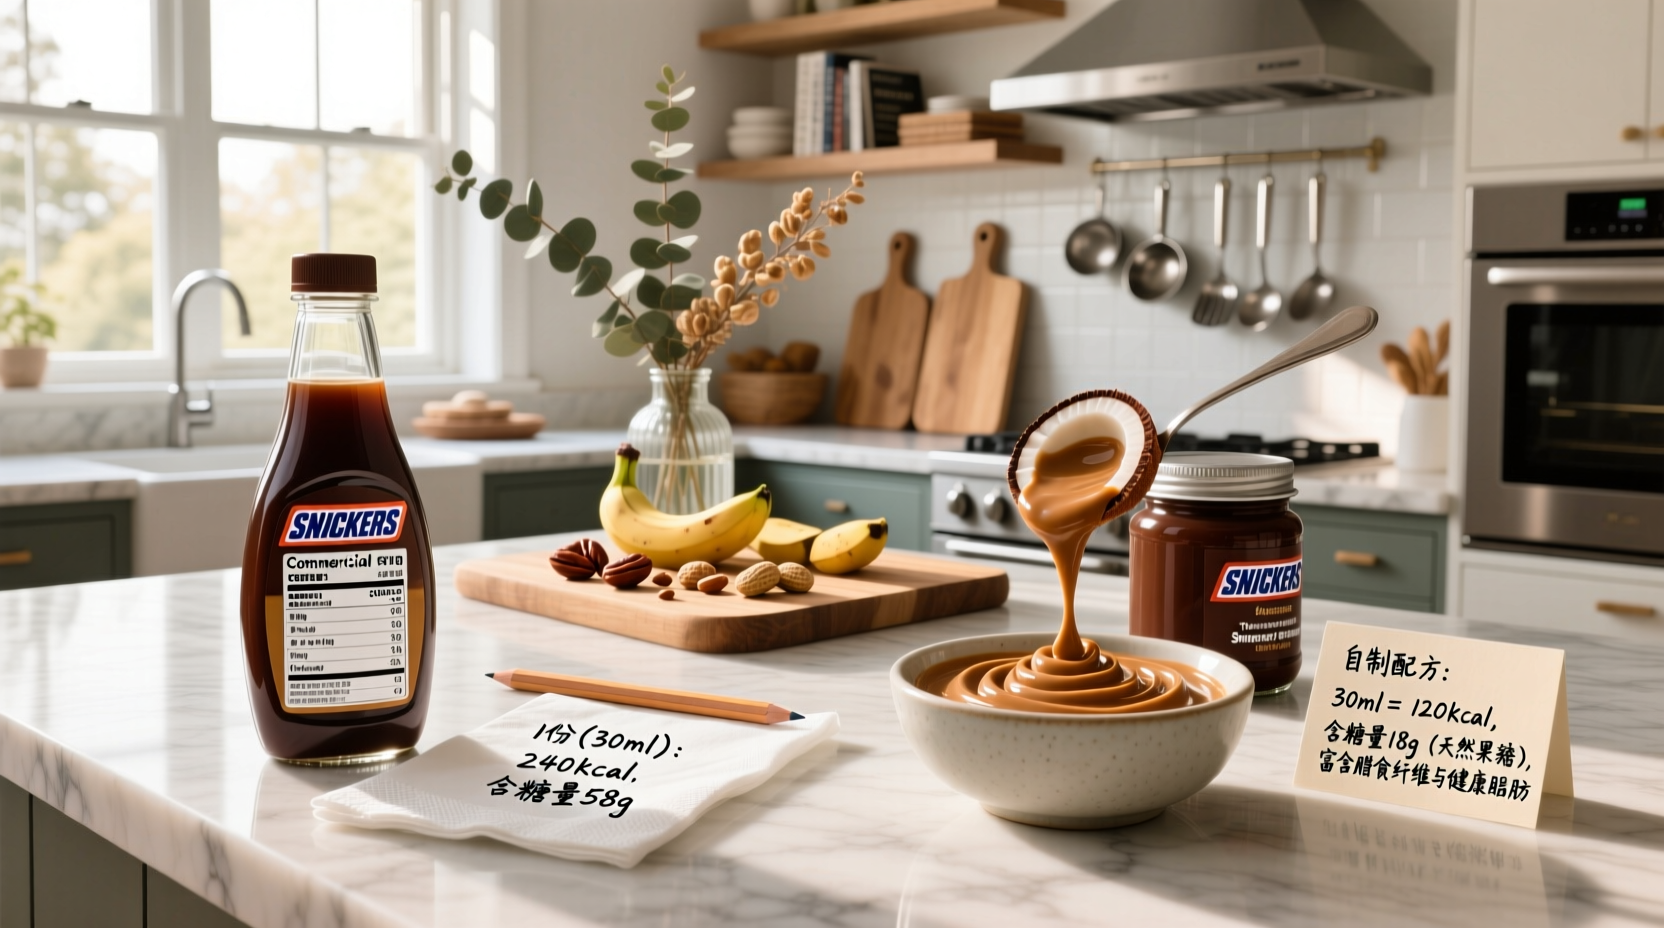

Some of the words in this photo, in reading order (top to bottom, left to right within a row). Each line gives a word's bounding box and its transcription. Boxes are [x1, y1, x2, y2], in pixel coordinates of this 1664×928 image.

[288, 508, 401, 540] SNICKERS
[286, 553, 372, 570] Commercial
[1344, 643, 1450, 682] 自制配方:
[1410, 697, 1498, 733] 120kcal,
[486, 774, 635, 819] 含糖量58g
